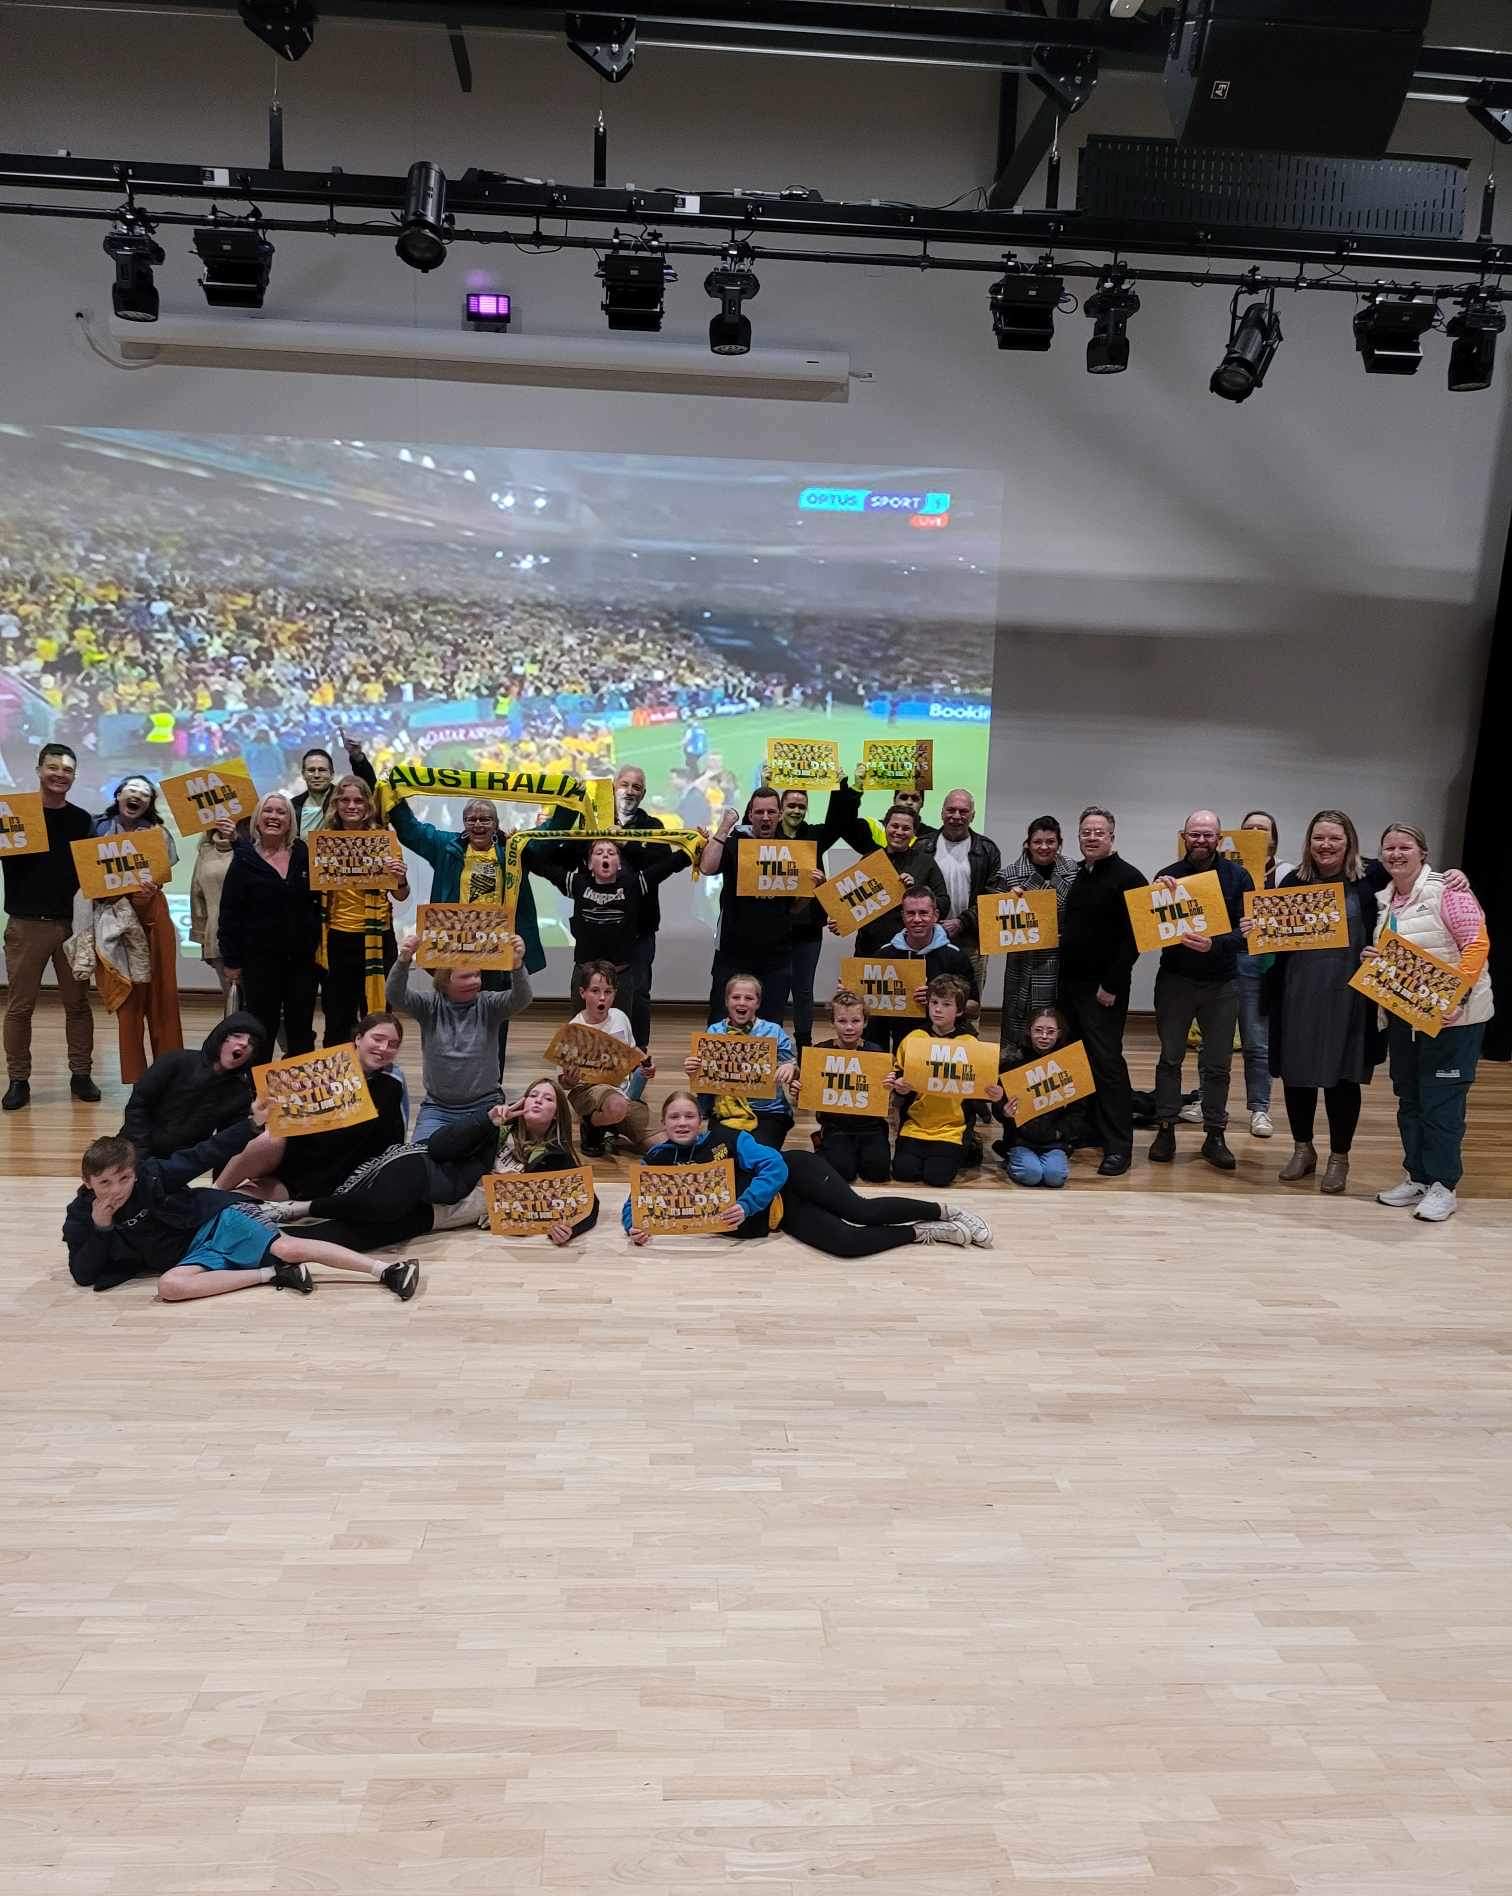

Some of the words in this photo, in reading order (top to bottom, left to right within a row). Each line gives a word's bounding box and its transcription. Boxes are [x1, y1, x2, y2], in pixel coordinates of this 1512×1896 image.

[806, 493, 857, 506] OPTUS
[871, 495, 921, 509] SPORT
[771, 759, 835, 770] MATILDAS
[186, 773, 224, 794] MA
[388, 765, 586, 801] AUSTRALIA
[0, 803, 14, 818] A
[198, 799, 242, 824] DAS
[0, 832, 27, 849] AS
[97, 840, 137, 858] MA
[1221, 836, 1237, 852] A
[315, 856, 384, 866] MATILDA
[759, 846, 793, 861] MA
[104, 868, 152, 890] DAS
[758, 875, 799, 890] DAS
[835, 870, 871, 897] MA
[850, 889, 892, 921] DAS
[1152, 884, 1192, 908] MA
[998, 898, 1031, 915] MA
[1000, 927, 1040, 945] DAS
[1158, 915, 1207, 939] DAS
[864, 965, 897, 980] MA
[864, 994, 906, 1010] DAS
[931, 1044, 968, 1064] MA
[826, 1055, 862, 1074] MA
[1025, 1061, 1062, 1086] MA
[282, 1076, 362, 1107] ATILDAS
[928, 1078, 976, 1095] DAS
[822, 1088, 870, 1108] DAS
[1033, 1083, 1076, 1111] DAS
[494, 1194, 588, 1213] MATILDAS
[637, 1190, 730, 1208] MATILDAS
